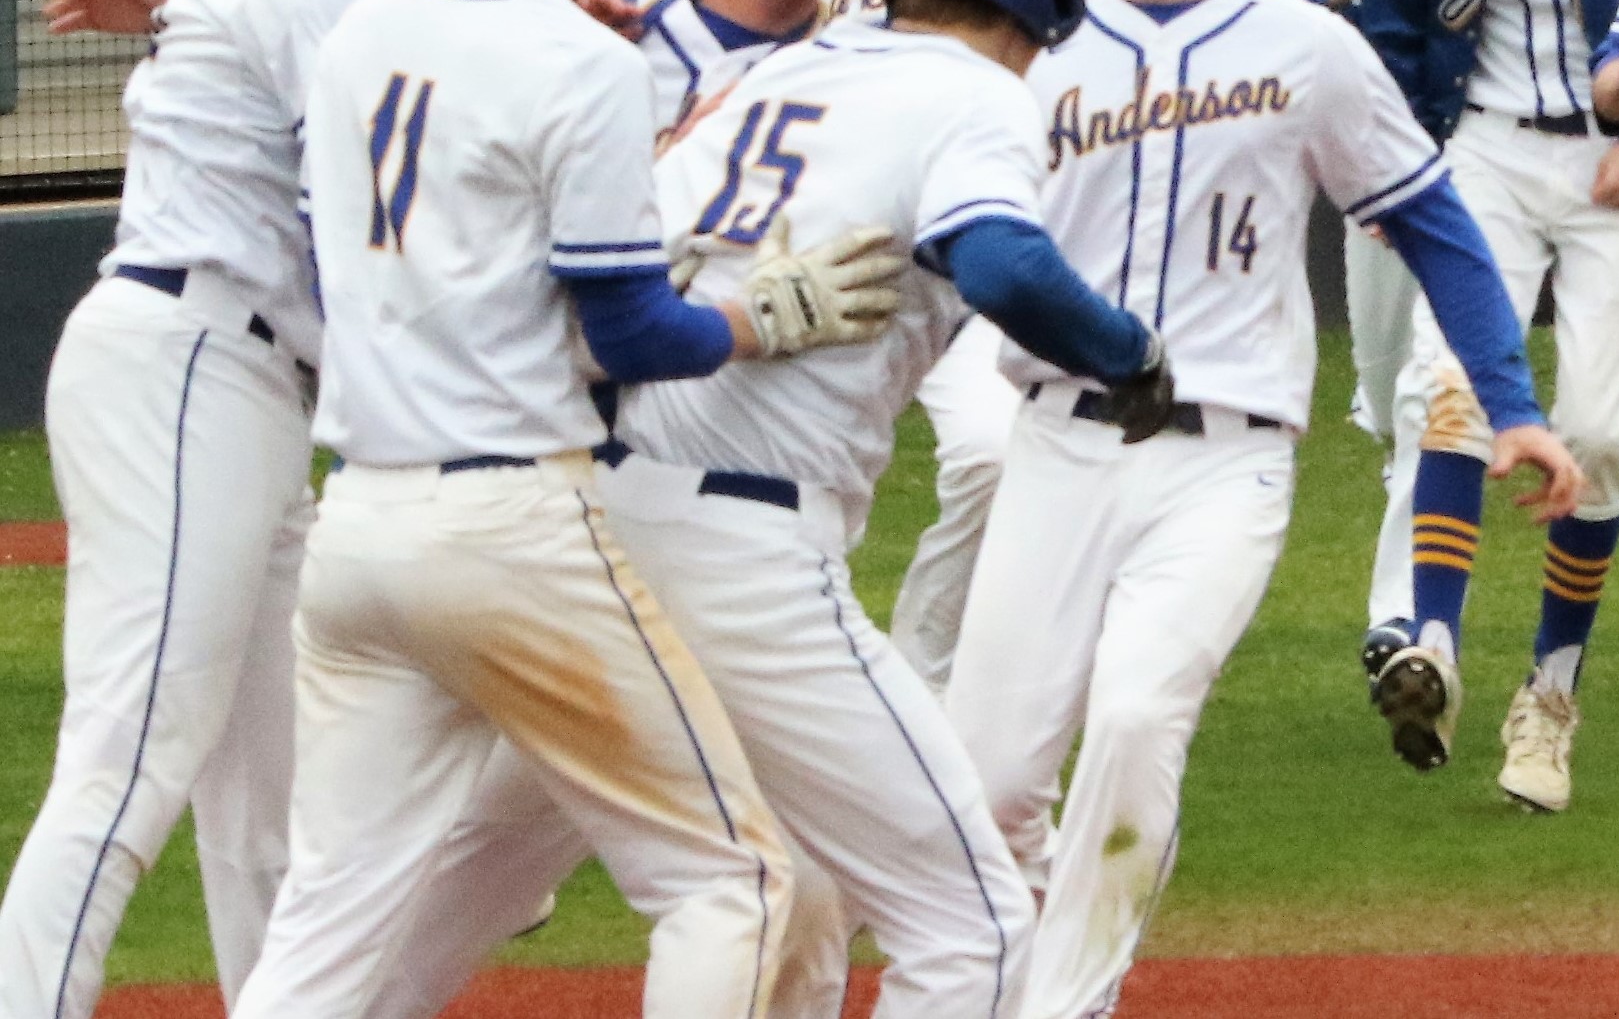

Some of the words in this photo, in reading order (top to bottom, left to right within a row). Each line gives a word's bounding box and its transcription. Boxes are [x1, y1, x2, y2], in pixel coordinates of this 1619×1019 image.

[1048, 65, 1290, 172] Anderson
[693, 99, 829, 247] 15
[1206, 192, 1258, 274] 14
